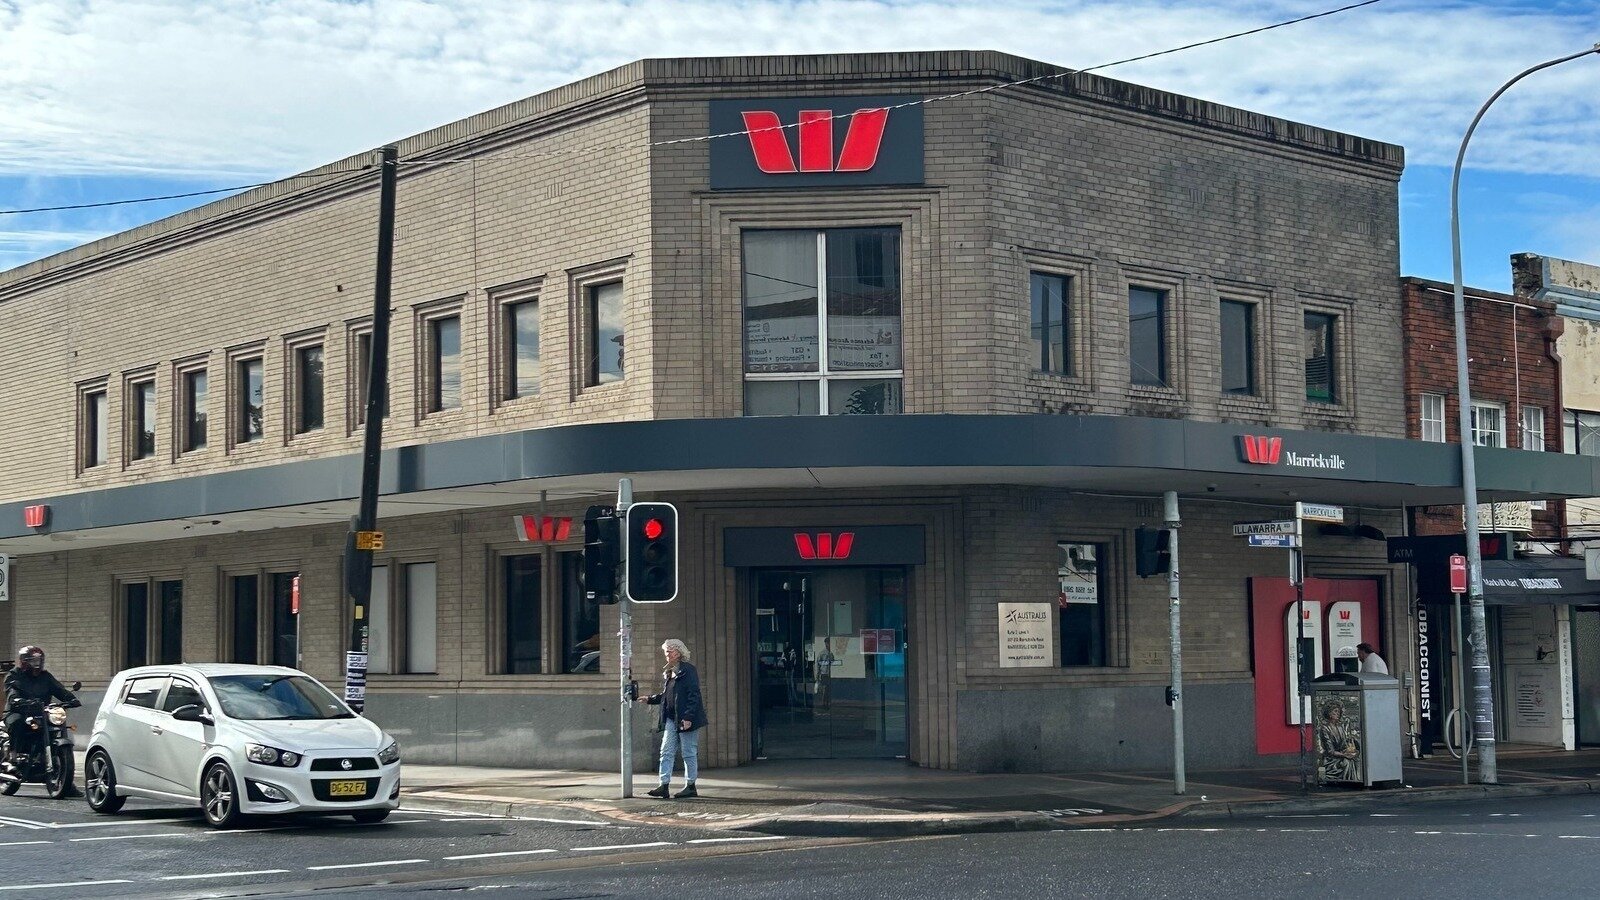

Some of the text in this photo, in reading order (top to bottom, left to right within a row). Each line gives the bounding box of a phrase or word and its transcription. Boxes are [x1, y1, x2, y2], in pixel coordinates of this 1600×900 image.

[1286, 451, 1346, 470] Marrickville
[1234, 524, 1282, 534] ILLAWARRA
[1394, 549, 1414, 558] ATM
[1017, 611, 1047, 620] AUSTRALIS
